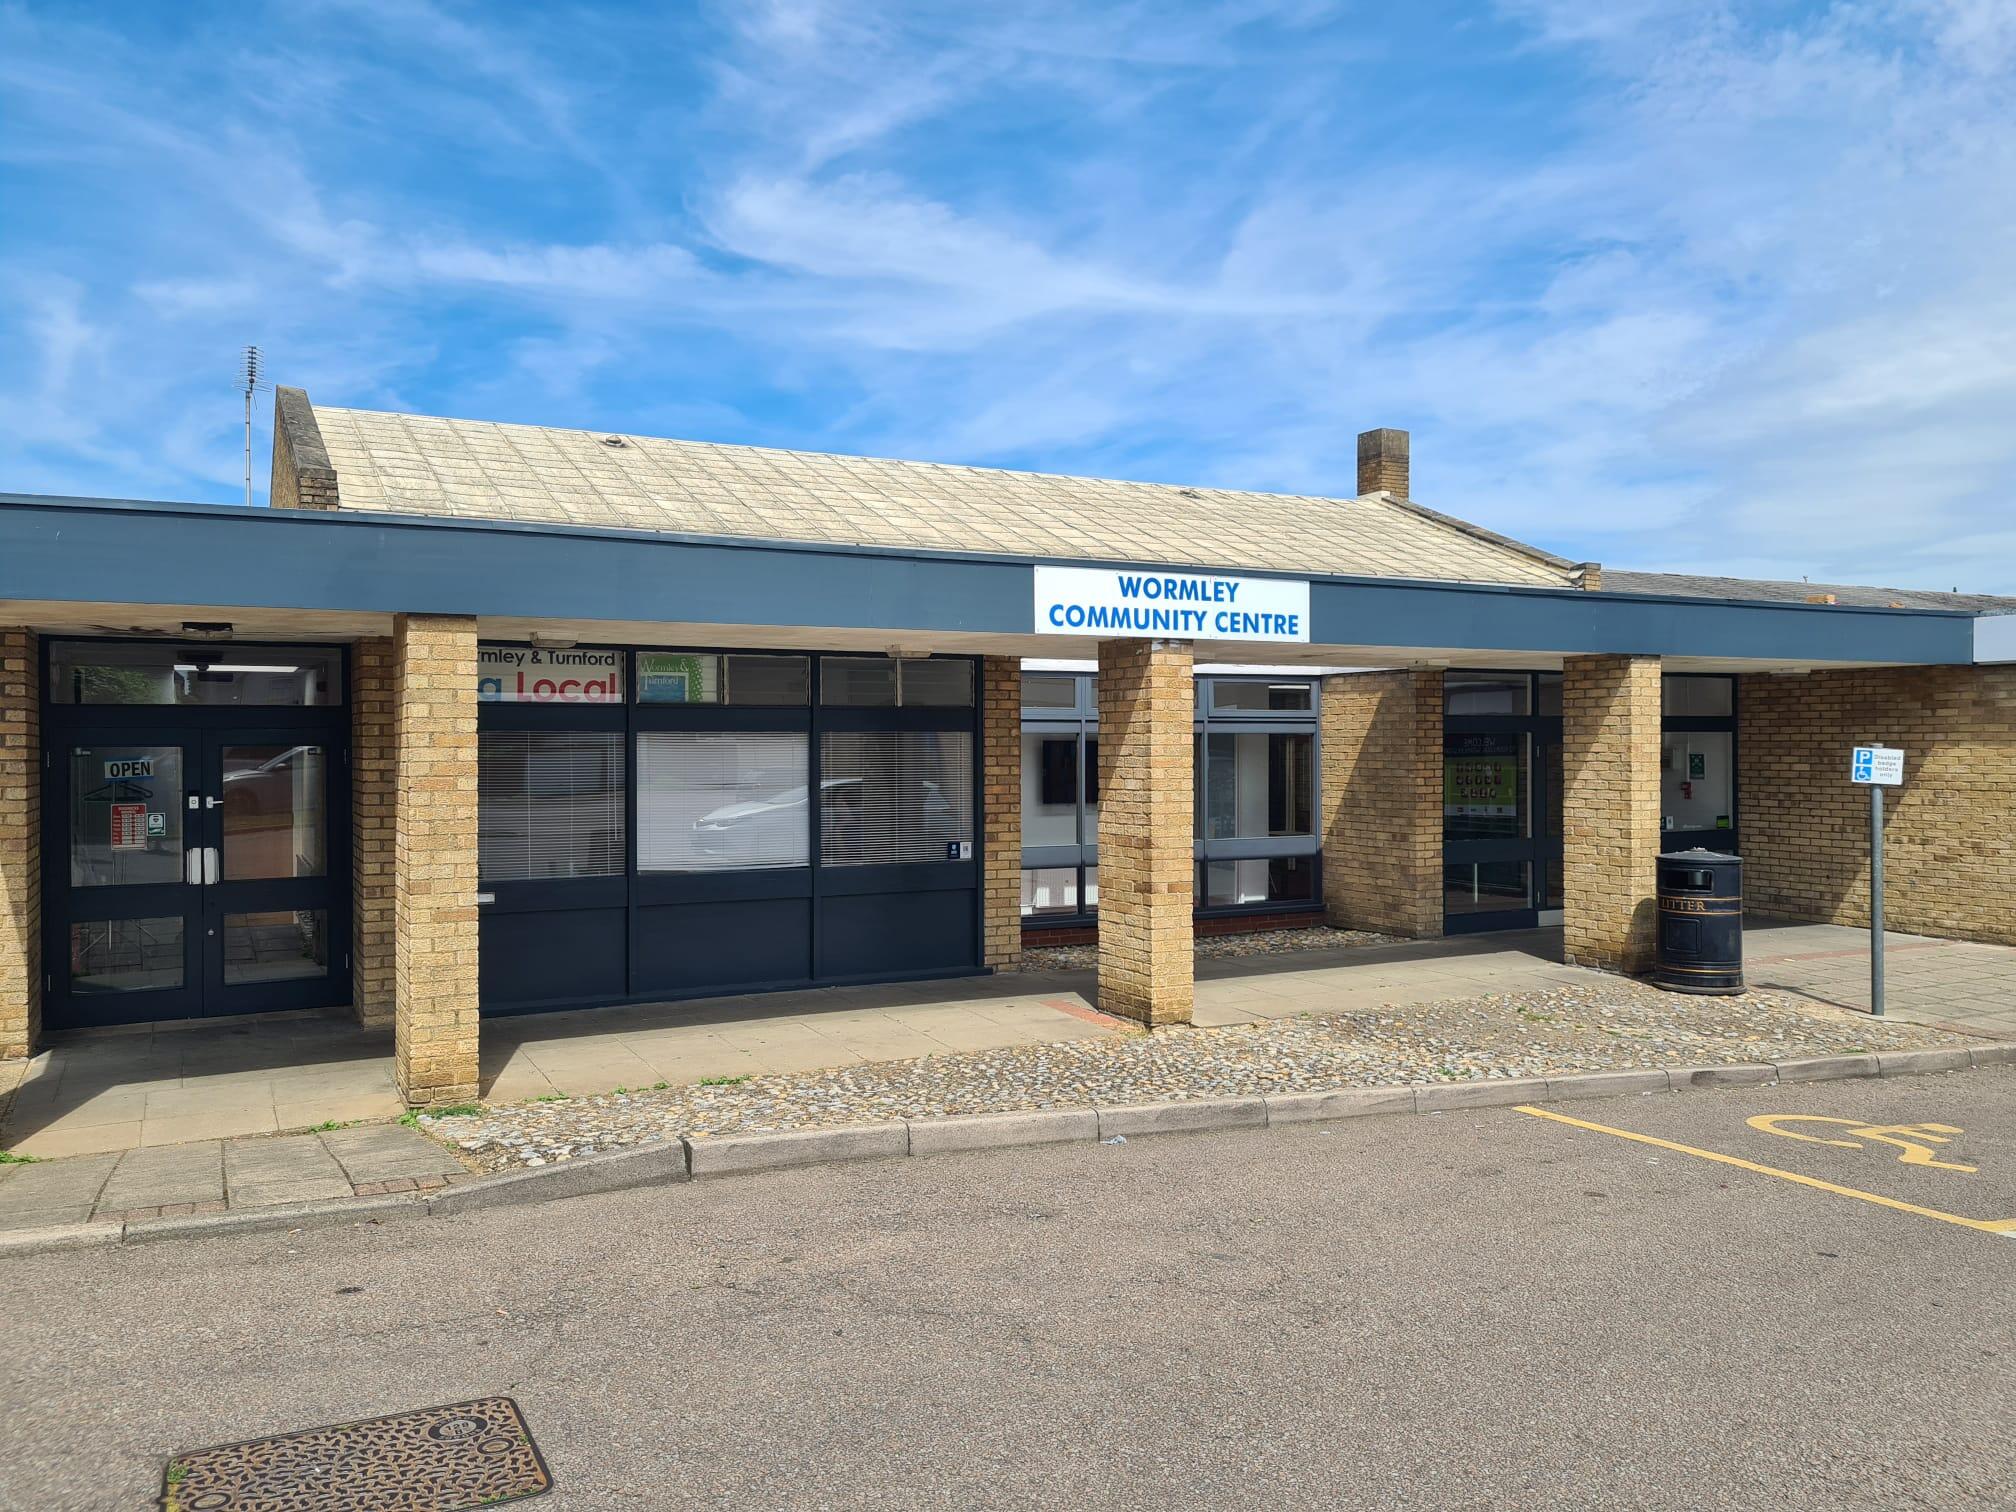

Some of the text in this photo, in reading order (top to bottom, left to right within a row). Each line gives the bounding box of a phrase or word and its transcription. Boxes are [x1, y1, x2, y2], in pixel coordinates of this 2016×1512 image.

[1117, 575, 1240, 603] WORMLEY
[1049, 604, 1299, 635] COMMUNITY CENTRE
[531, 650, 542, 664] &
[547, 650, 616, 666] Turnford
[640, 658, 679, 673] Wormley
[517, 671, 616, 703] Local
[1860, 751, 1871, 764] P
[110, 761, 151, 777] OPEN
[1662, 897, 1706, 912] LITTER
